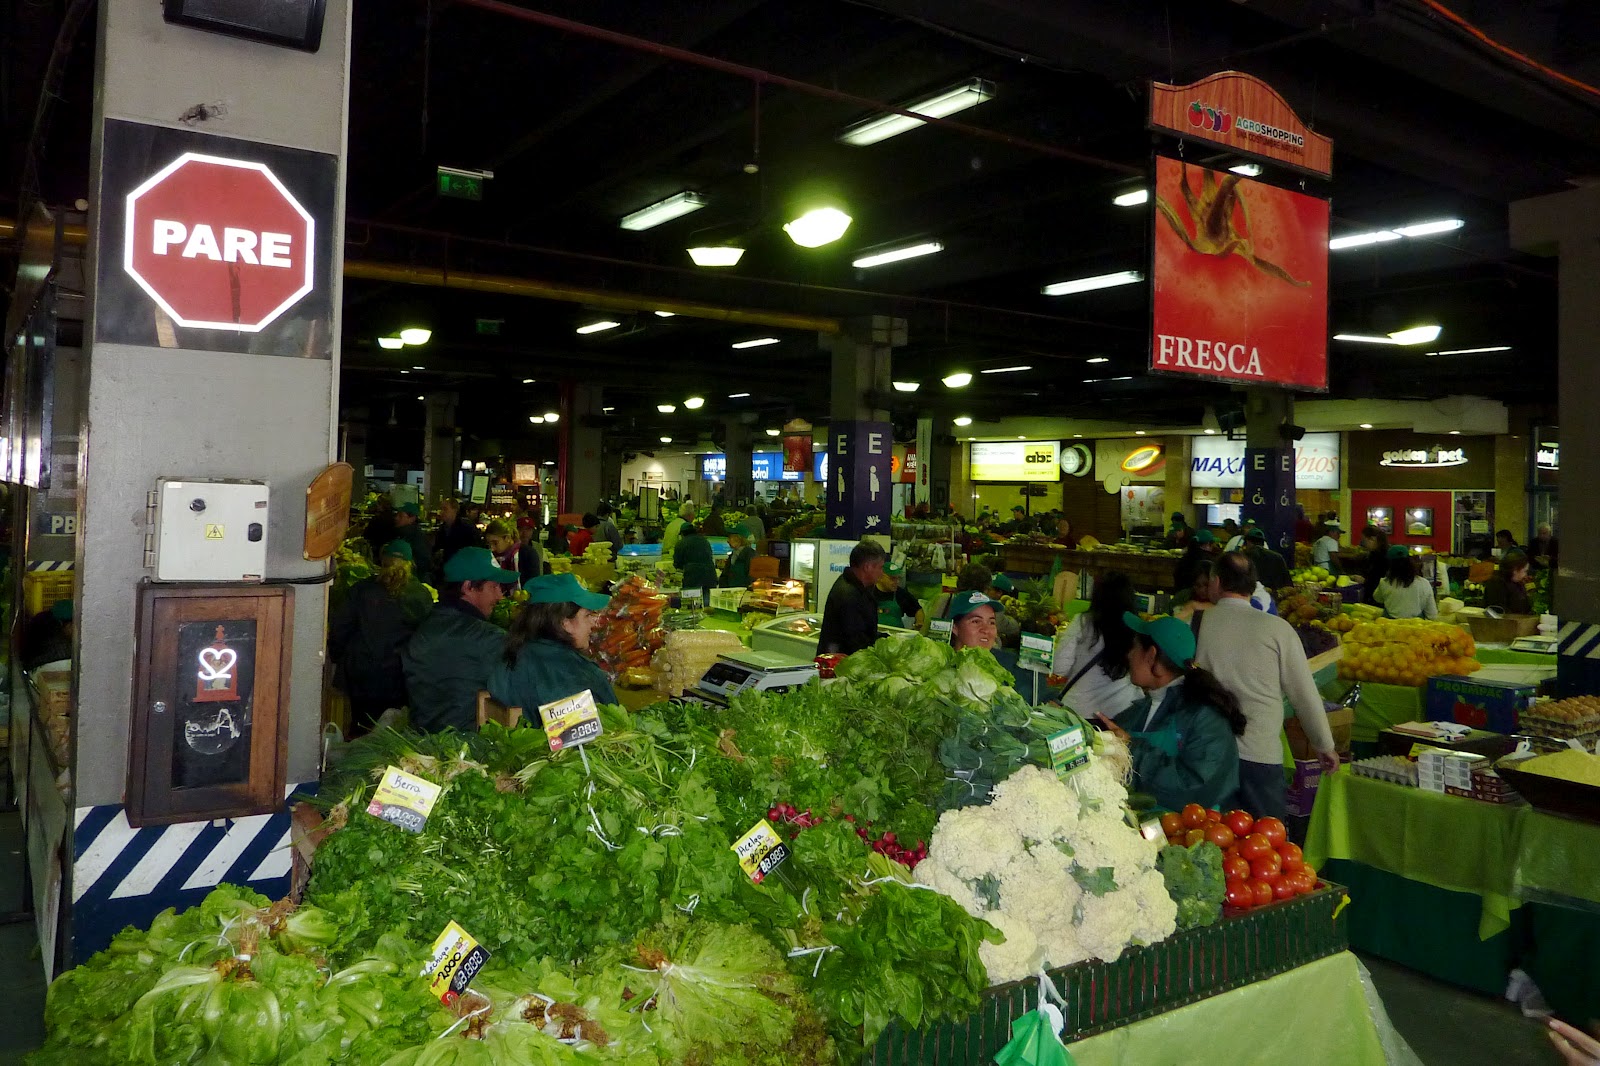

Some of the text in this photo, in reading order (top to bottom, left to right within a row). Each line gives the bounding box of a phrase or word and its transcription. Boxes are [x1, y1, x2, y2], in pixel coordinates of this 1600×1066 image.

[1235, 117, 1304, 147] AGROSHOPPING
[153, 219, 292, 268] PARE
[1157, 334, 1264, 376] FRESCA
[837, 434, 848, 455] E
[868, 432, 883, 454] E
[1025, 451, 1052, 464] abc
[1253, 454, 1266, 471] E
[1281, 455, 1290, 472] E
[1382, 448, 1464, 464] golden pet
[51, 515, 77, 533] PB
[549, 699, 582, 720] Rucula
[737, 834, 764, 857] Acelga
[428, 946, 450, 974] echuga
